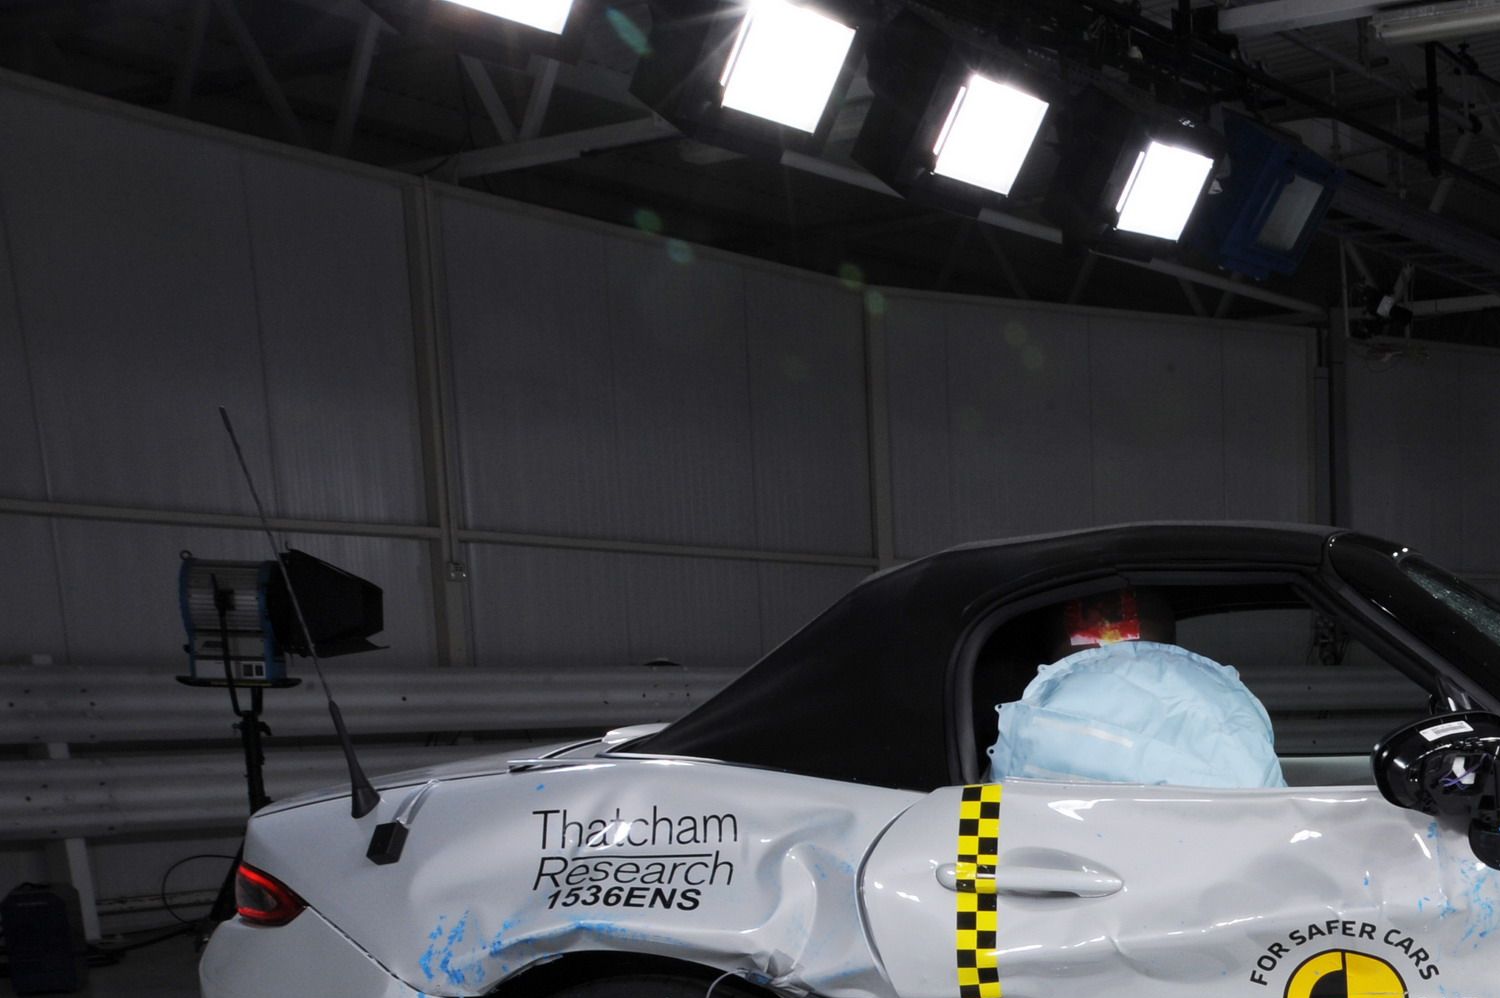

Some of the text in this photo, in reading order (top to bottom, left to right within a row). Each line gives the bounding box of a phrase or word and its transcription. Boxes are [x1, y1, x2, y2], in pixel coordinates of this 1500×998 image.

[531, 805, 738, 850] Thatcham
[532, 850, 735, 891] Research
[547, 885, 702, 911] 1536ENS
[1250, 919, 1440, 986] FOR SAFER CARS
